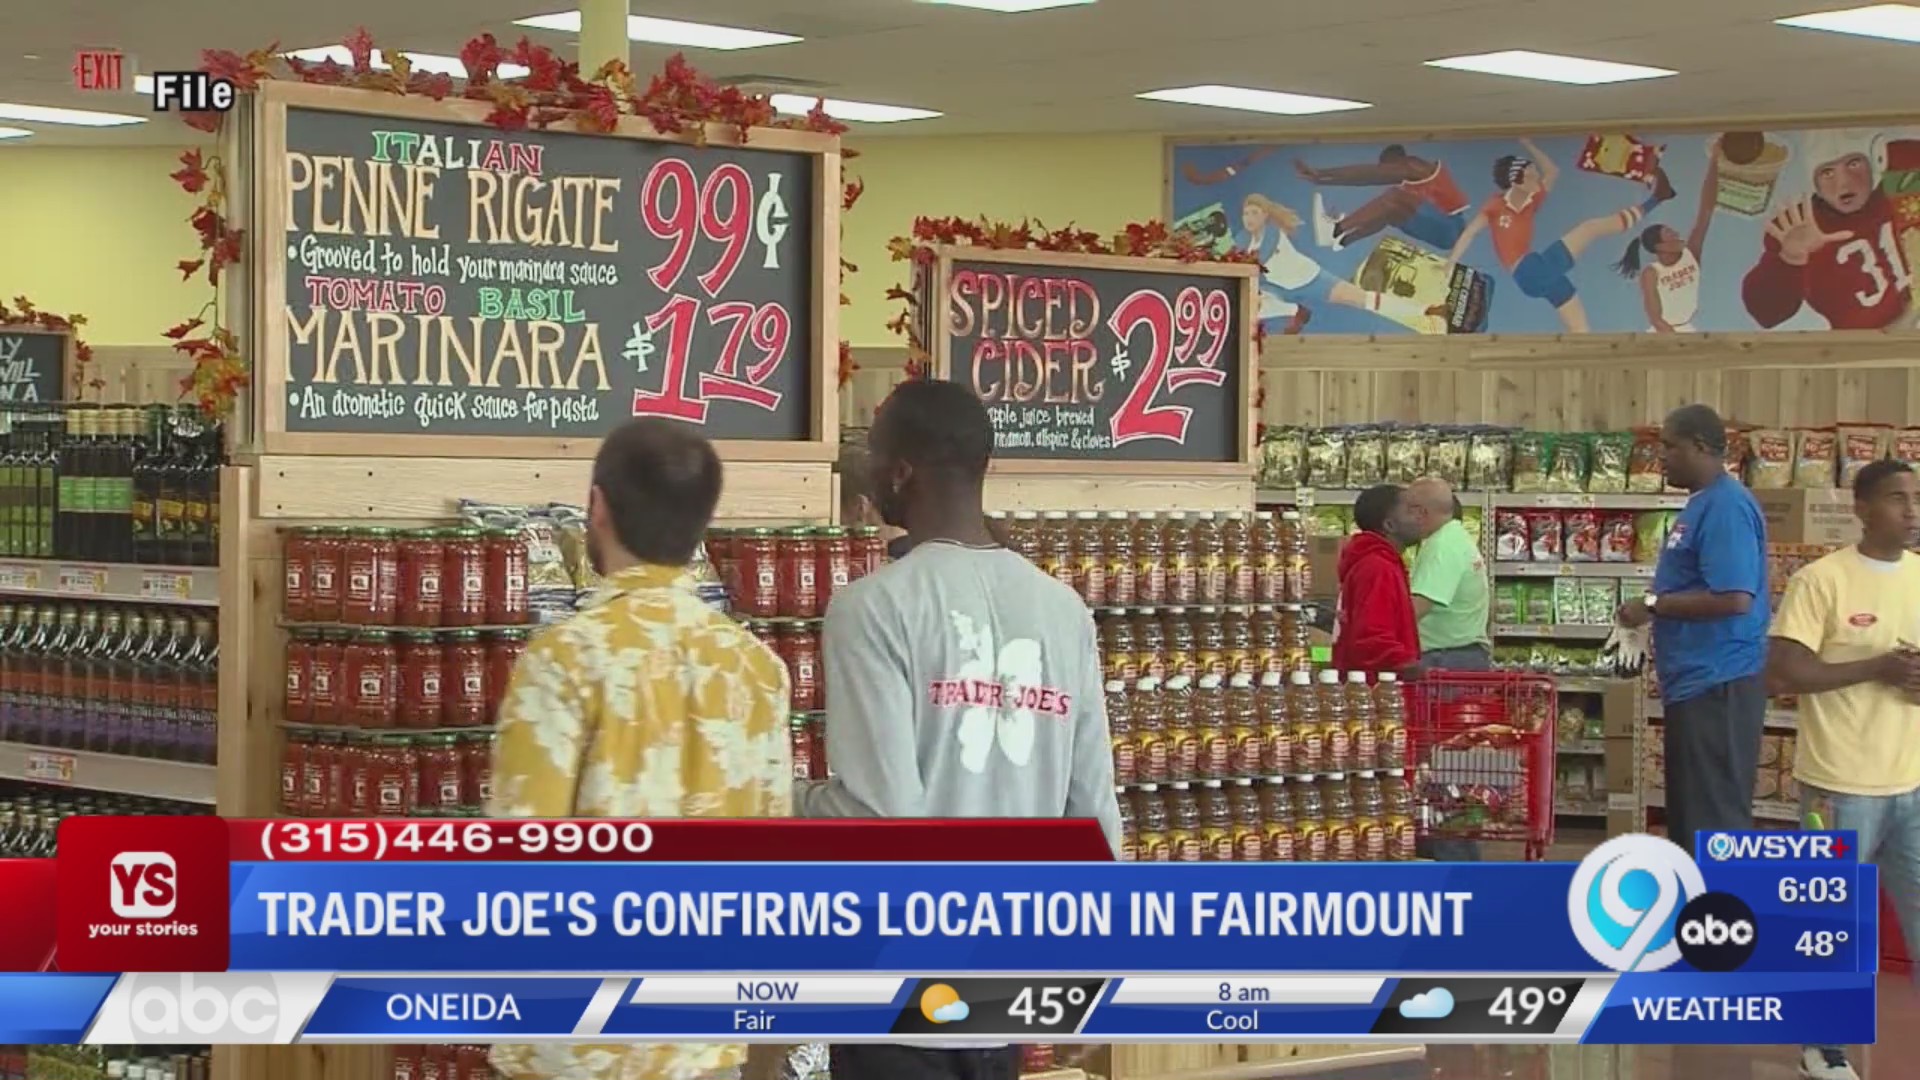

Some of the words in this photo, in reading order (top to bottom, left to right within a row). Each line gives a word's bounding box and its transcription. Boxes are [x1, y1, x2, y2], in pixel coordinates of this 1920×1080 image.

[79, 54, 121, 89] EXIT
[372, 131, 544, 176] ITALIAN
[286, 153, 440, 238] PENNE
[467, 170, 621, 253] RIGATE
[300, 234, 375, 273] Grooved
[381, 248, 403, 272] to
[411, 245, 450, 276] hold
[457, 255, 498, 284] your
[499, 259, 564, 284] marinara
[570, 263, 619, 286] sauce
[1836, 221, 1912, 307] 31
[305, 276, 446, 316] TOMATO
[478, 287, 586, 323] BASIL
[949, 269, 1100, 339] SPICED
[285, 306, 612, 391] MARINARA
[972, 338, 1105, 403] CIDER
[300, 385, 326, 418] An
[332, 388, 406, 419] aromatic
[414, 391, 467, 428] quick
[471, 393, 519, 418] sauce
[523, 391, 548, 422] for
[551, 399, 600, 428] pasta
[1018, 407, 1052, 429] juice
[1055, 404, 1095, 427] brewed
[1070, 427, 1082, 449] &
[1013, 683, 1071, 716] JOE'S
